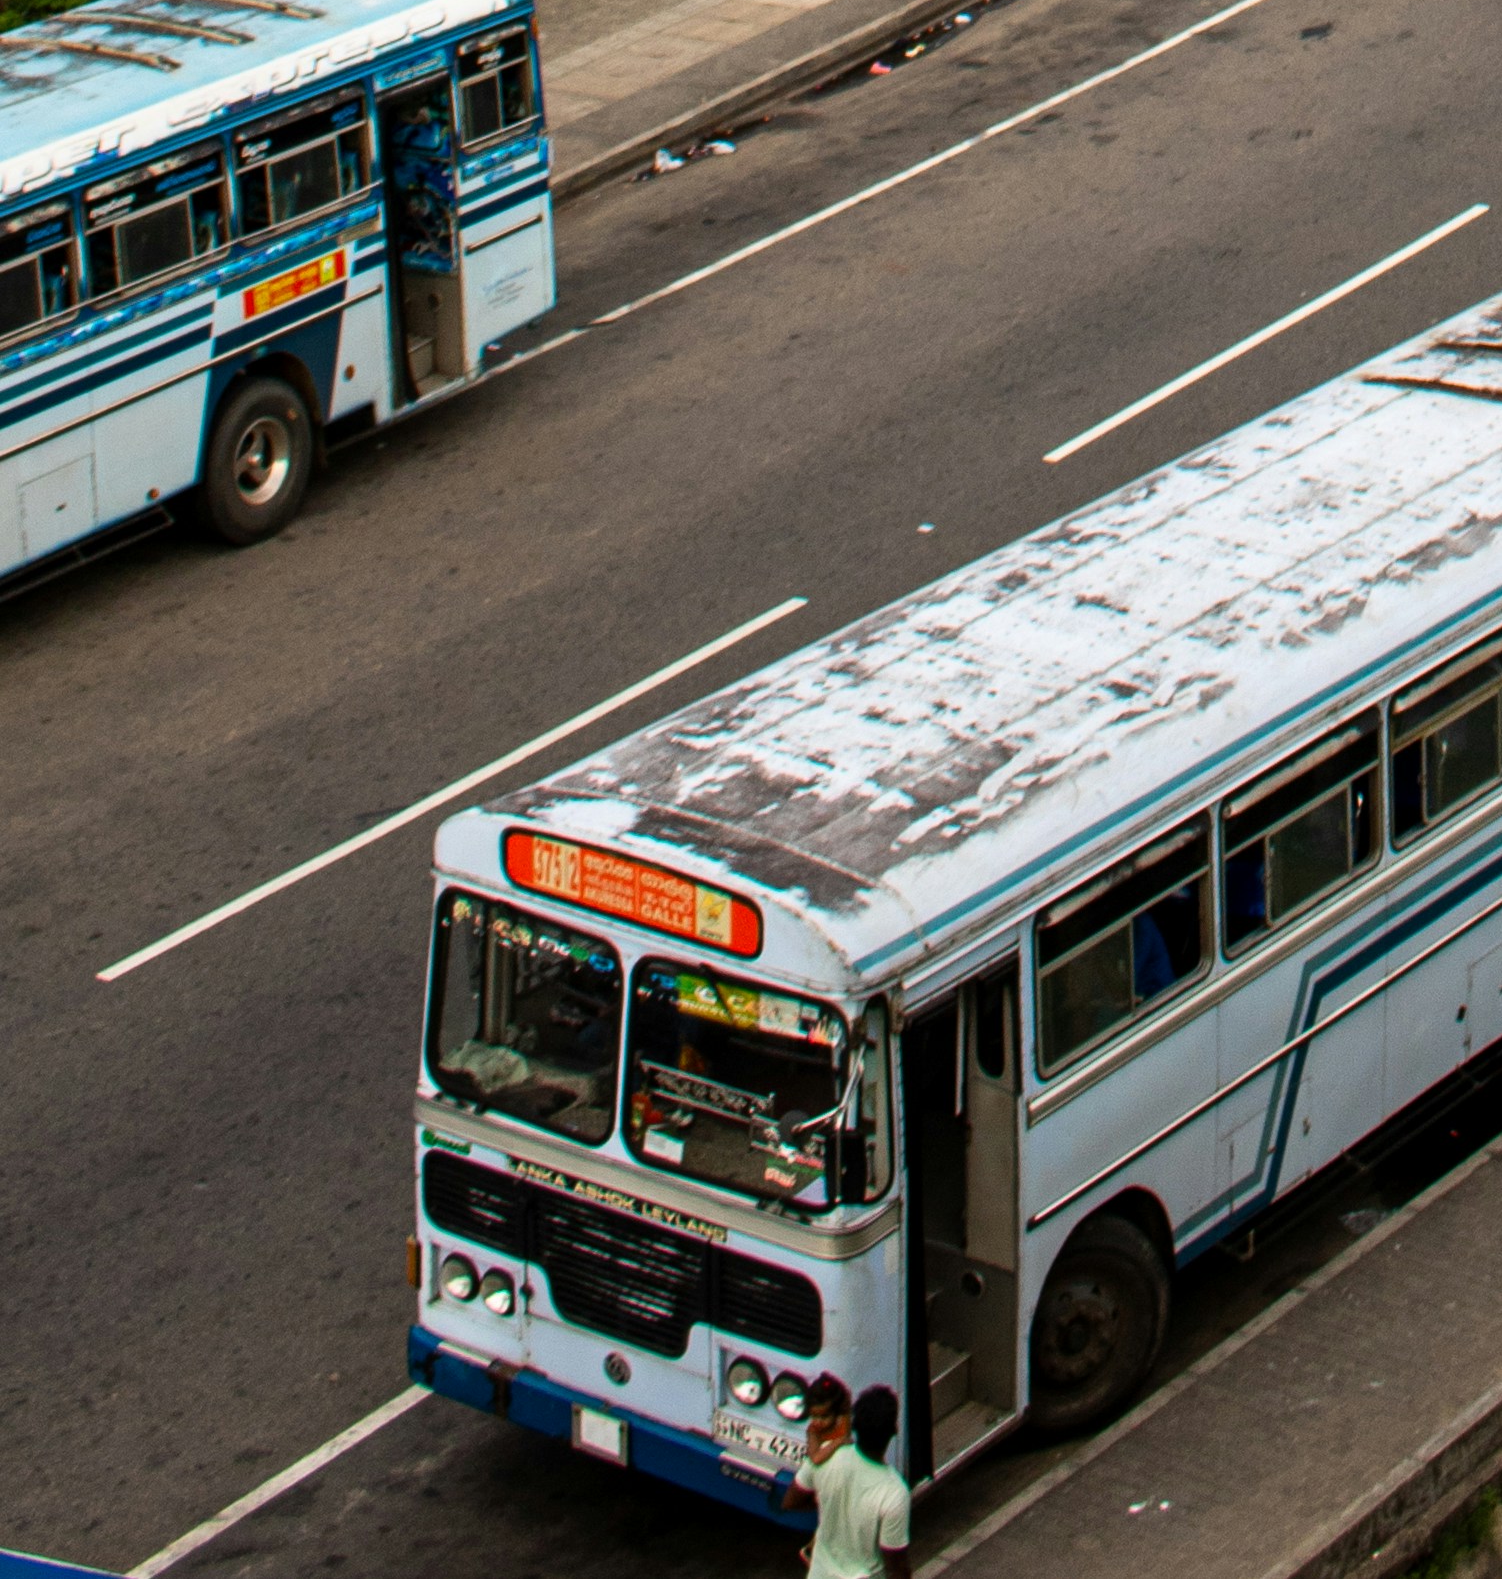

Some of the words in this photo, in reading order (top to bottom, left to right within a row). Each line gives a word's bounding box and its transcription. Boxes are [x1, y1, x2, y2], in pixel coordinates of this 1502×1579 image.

[640, 905, 693, 931] GALLE
[508, 1156, 567, 1188] LANKA
[574, 1180, 635, 1211] ASHOK
[641, 1202, 728, 1243] LEYLAND
